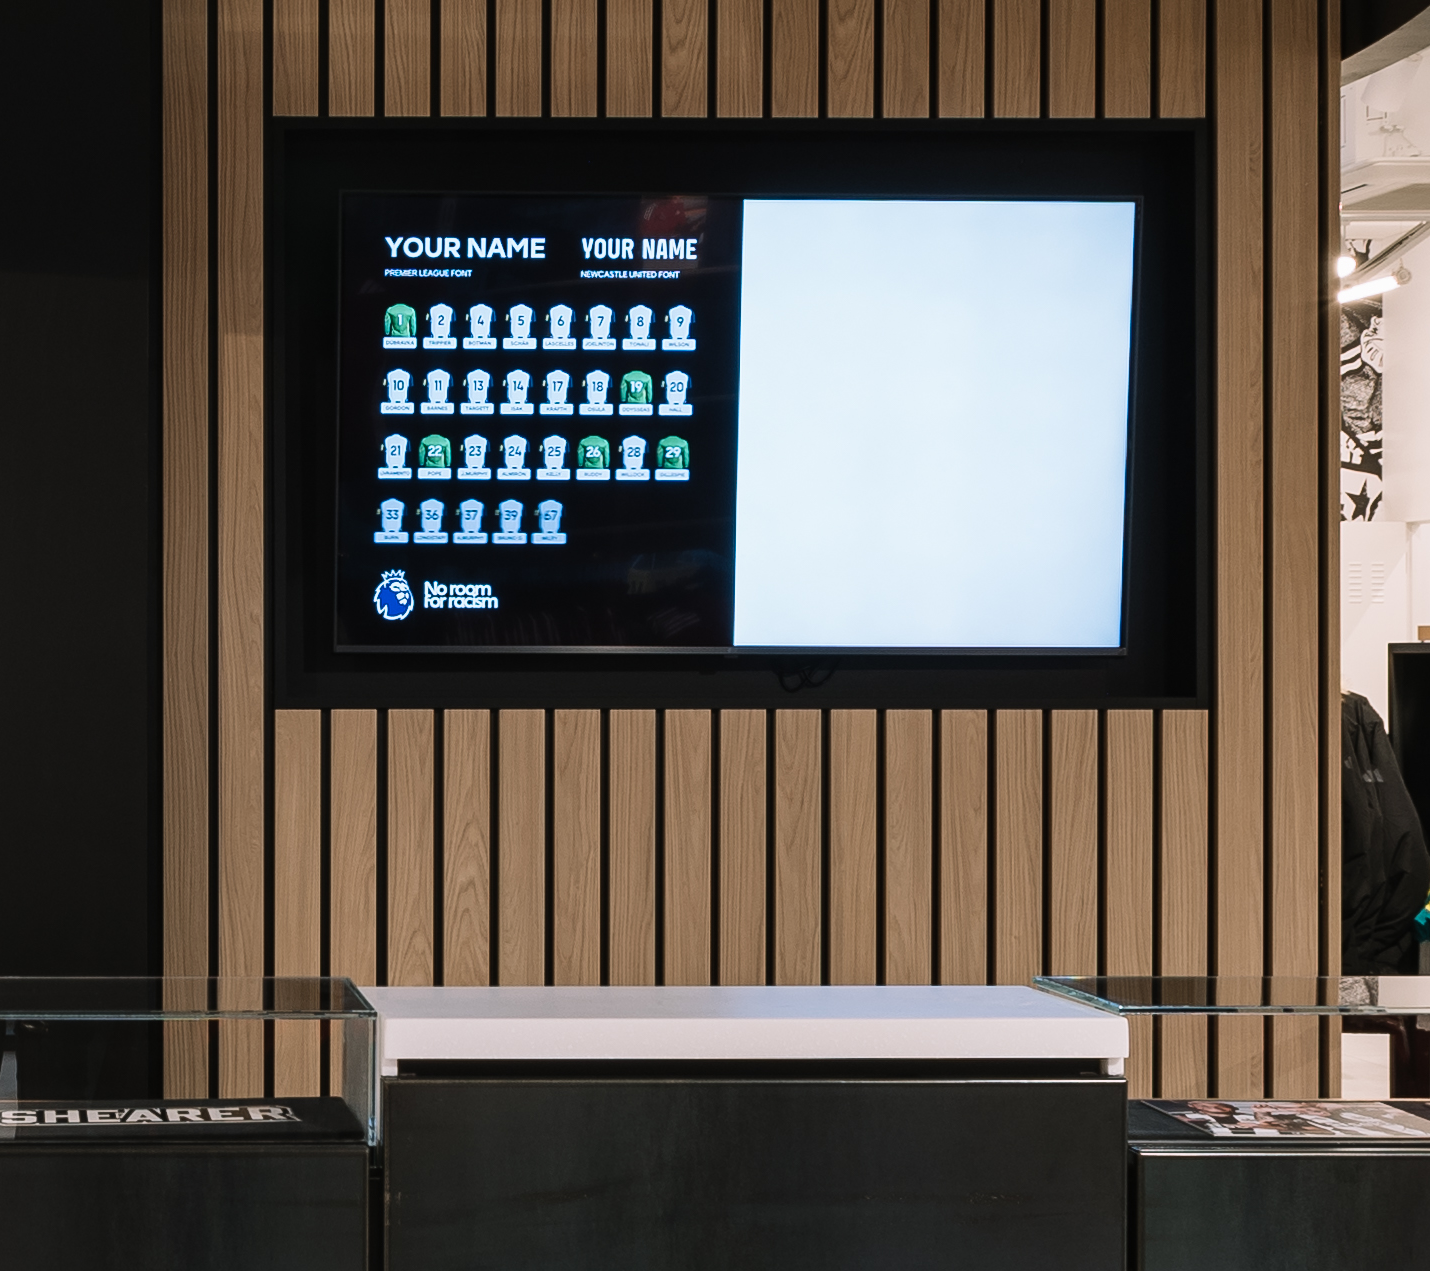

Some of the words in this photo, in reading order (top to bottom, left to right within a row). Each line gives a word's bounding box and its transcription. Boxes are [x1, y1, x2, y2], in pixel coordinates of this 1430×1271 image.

[385, 237, 460, 258] YOUR
[467, 238, 545, 258] NAME
[582, 238, 634, 259] YOUR
[642, 239, 697, 259] NAME
[419, 269, 449, 277] LEAGUE
[451, 269, 472, 277] FONT
[581, 270, 628, 278] NEWCASTLE
[397, 314, 403, 326] 1
[437, 314, 445, 326] 2
[477, 315, 485, 326] 4
[517, 315, 525, 326] 5
[557, 315, 565, 327] 6
[597, 315, 605, 327] 7
[636, 315, 645, 327] 8
[676, 316, 685, 328] 9
[393, 379, 405, 391] 10
[434, 379, 442, 391] 11
[473, 380, 484, 392] 13
[512, 380, 524, 391] 14
[552, 380, 564, 392] 17
[592, 381, 604, 392] 18
[630, 381, 643, 392] 19
[669, 381, 684, 393] 20
[390, 444, 401, 457] 21
[427, 445, 442, 457] 22
[468, 445, 482, 457] 23
[508, 445, 522, 457] 24
[547, 446, 562, 457] 25
[586, 446, 601, 458] 26
[627, 446, 642, 458] 28
[665, 447, 682, 459] 29
[385, 509, 399, 520] 33
[425, 509, 440, 521] 36
[464, 509, 479, 521] 37
[504, 509, 519, 521] 39
[542, 509, 558, 521] 67
[424, 581, 447, 596] No
[450, 584, 491, 596] room
[424, 597, 447, 608] for
[448, 597, 498, 608] racism
[0, 1106, 287, 1124] SHEARER
